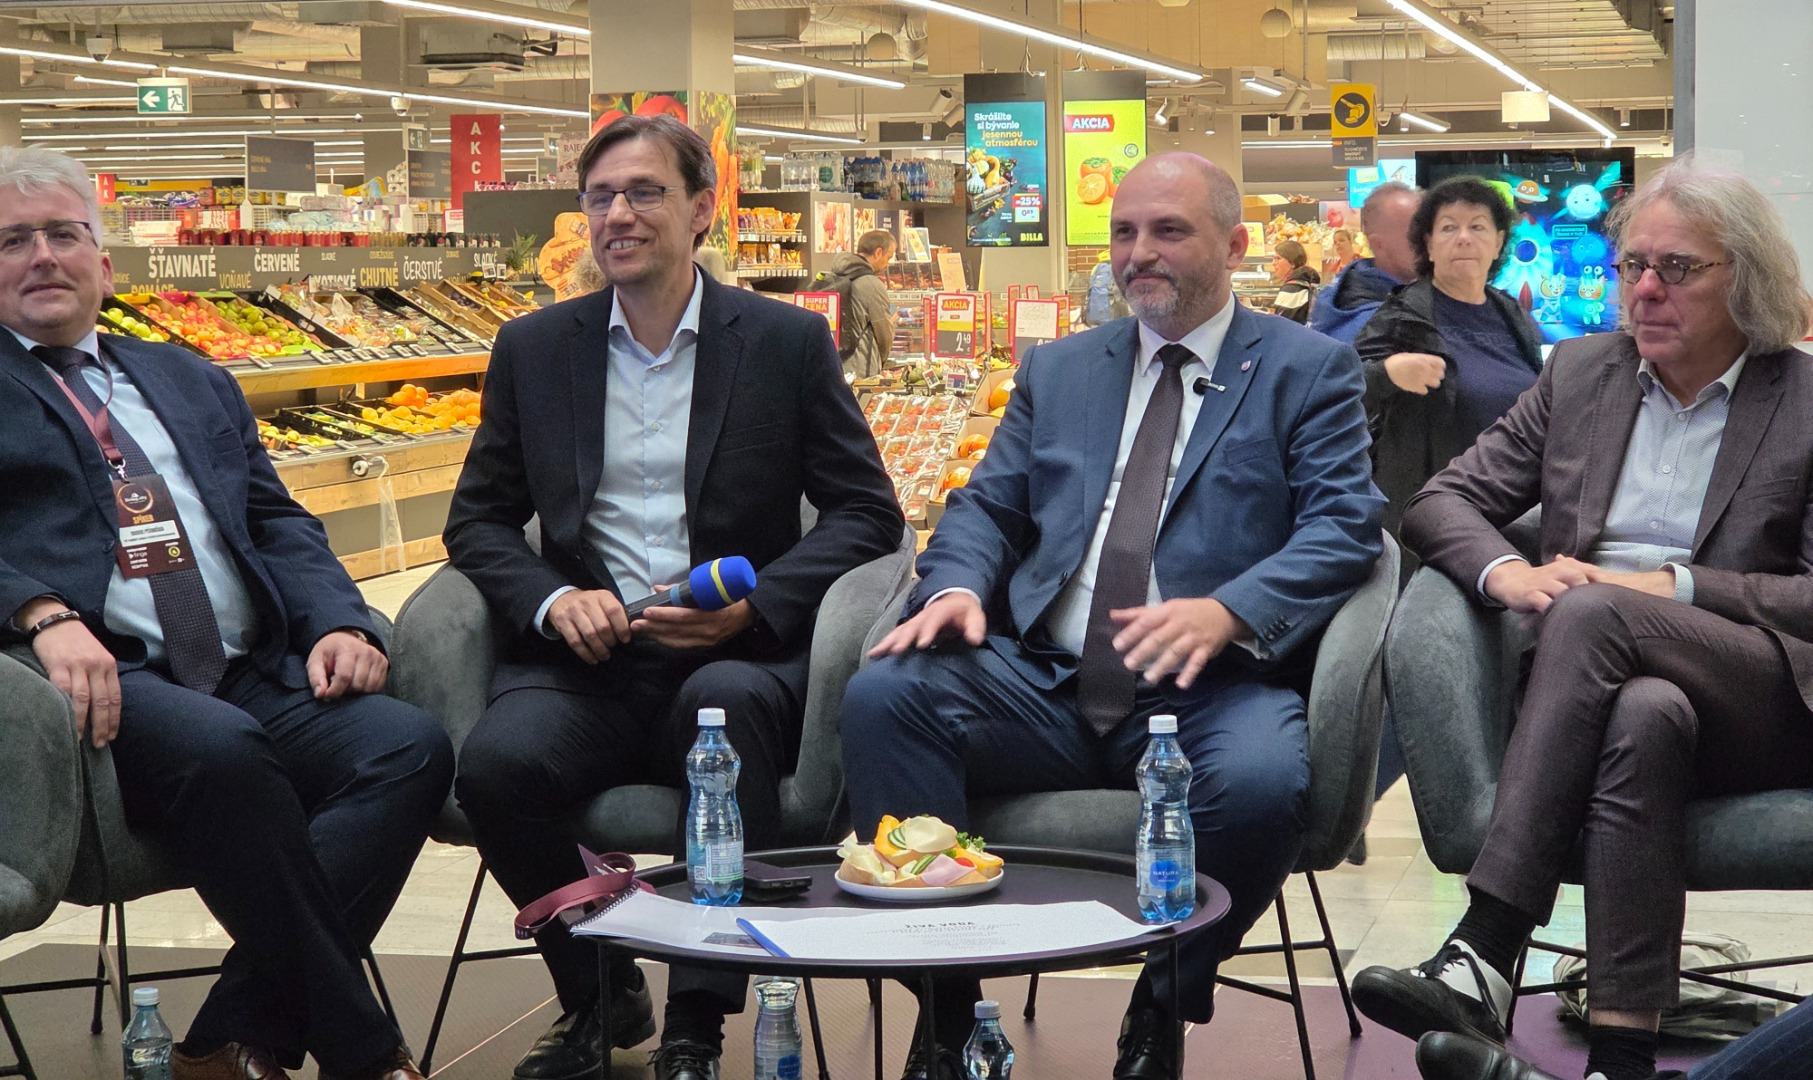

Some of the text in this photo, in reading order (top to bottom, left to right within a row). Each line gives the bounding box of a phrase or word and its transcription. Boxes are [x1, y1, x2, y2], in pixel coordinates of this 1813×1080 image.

[977, 121, 1020, 131] si bývanie
[1072, 117, 1110, 129] AKCIA
[981, 130, 1023, 141] jesennou
[985, 138, 1038, 147] atmosférou
[1015, 197, 1041, 206] -25%
[1020, 233, 1043, 241] BILLA
[148, 247, 217, 278] ŠŤAVNATÉ
[254, 247, 300, 272] ČERVENÉ
[403, 255, 444, 281] ČERSTVÉ
[219, 269, 252, 289] VOŇAVÉ
[359, 261, 399, 287] CHUTNÉ
[943, 301, 968, 309] AKCIA
